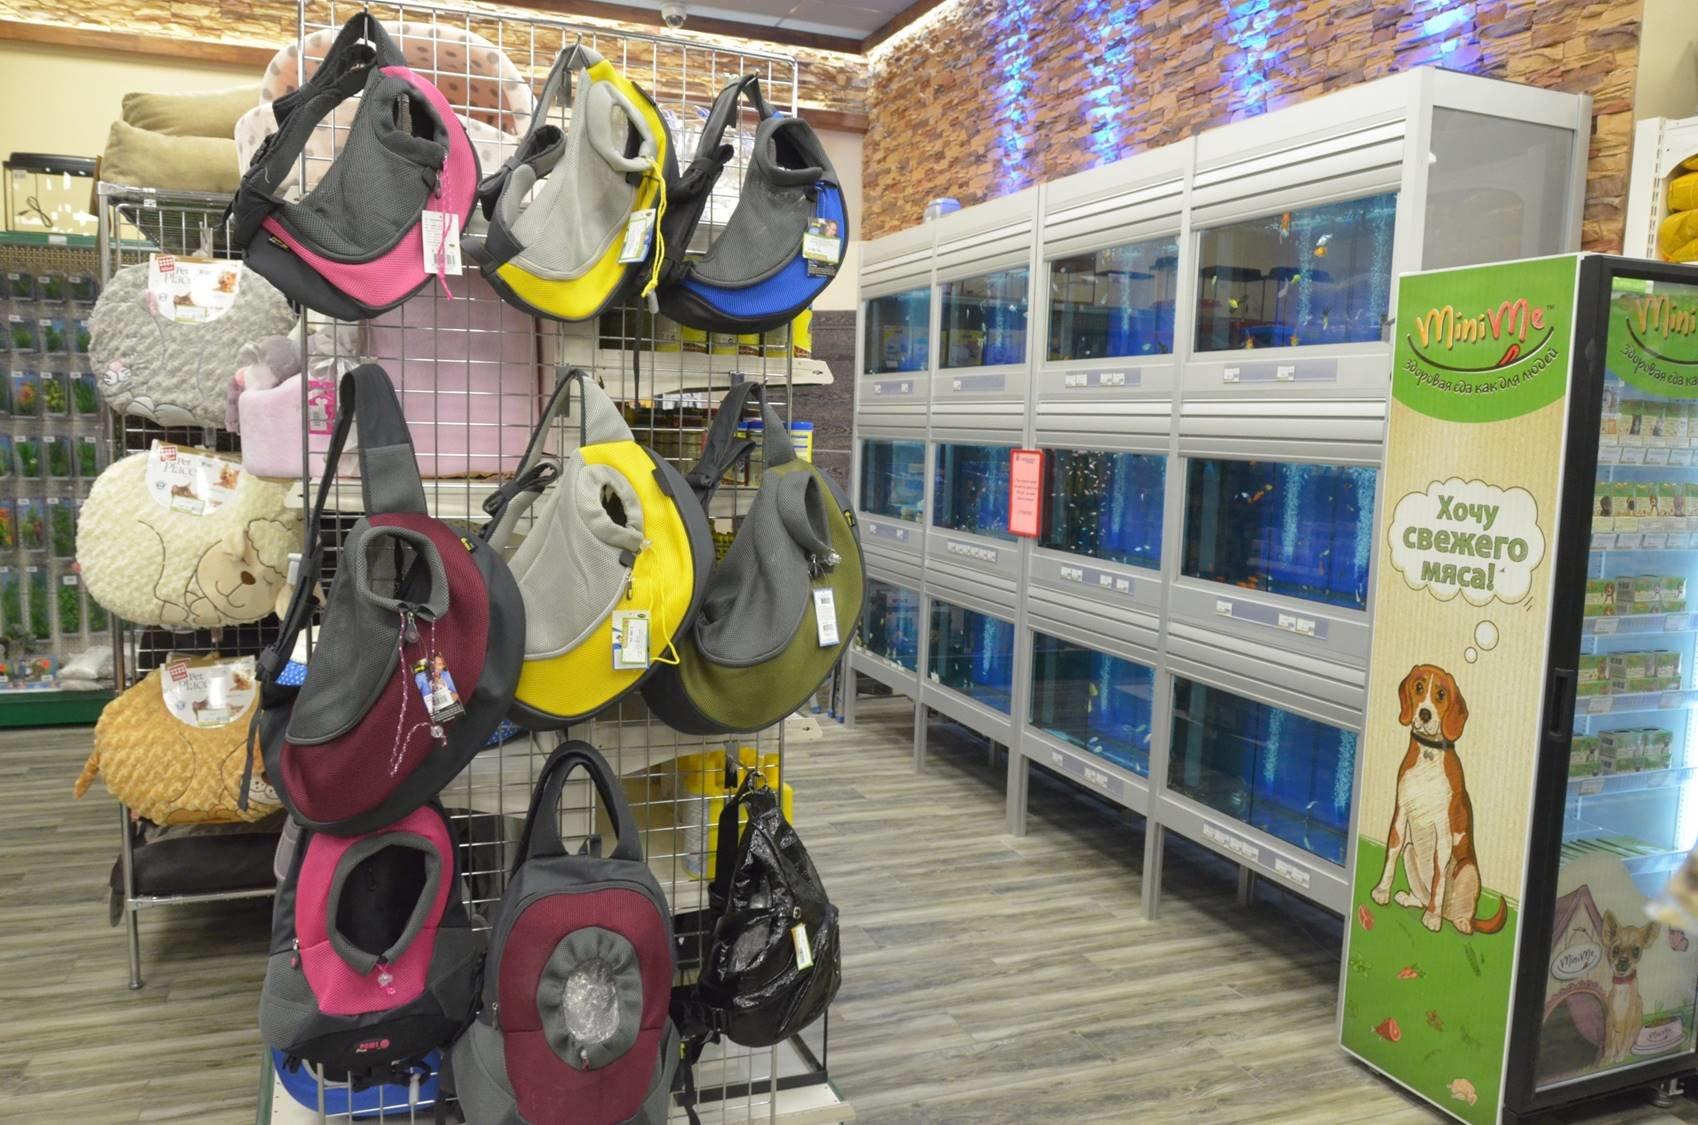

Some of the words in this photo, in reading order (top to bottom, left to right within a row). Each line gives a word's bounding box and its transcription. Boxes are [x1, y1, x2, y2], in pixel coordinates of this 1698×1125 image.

[1453, 379, 1473, 393] еда
[1475, 381, 1498, 393] как
[1500, 376, 1520, 390] для
[1522, 348, 1559, 382] людей
[1667, 371, 1684, 386] еда
[1685, 376, 1698, 386] ка
[1436, 494, 1500, 532] Хочу
[1402, 526, 1529, 563] свежего
[1420, 560, 1496, 592] мяса!
